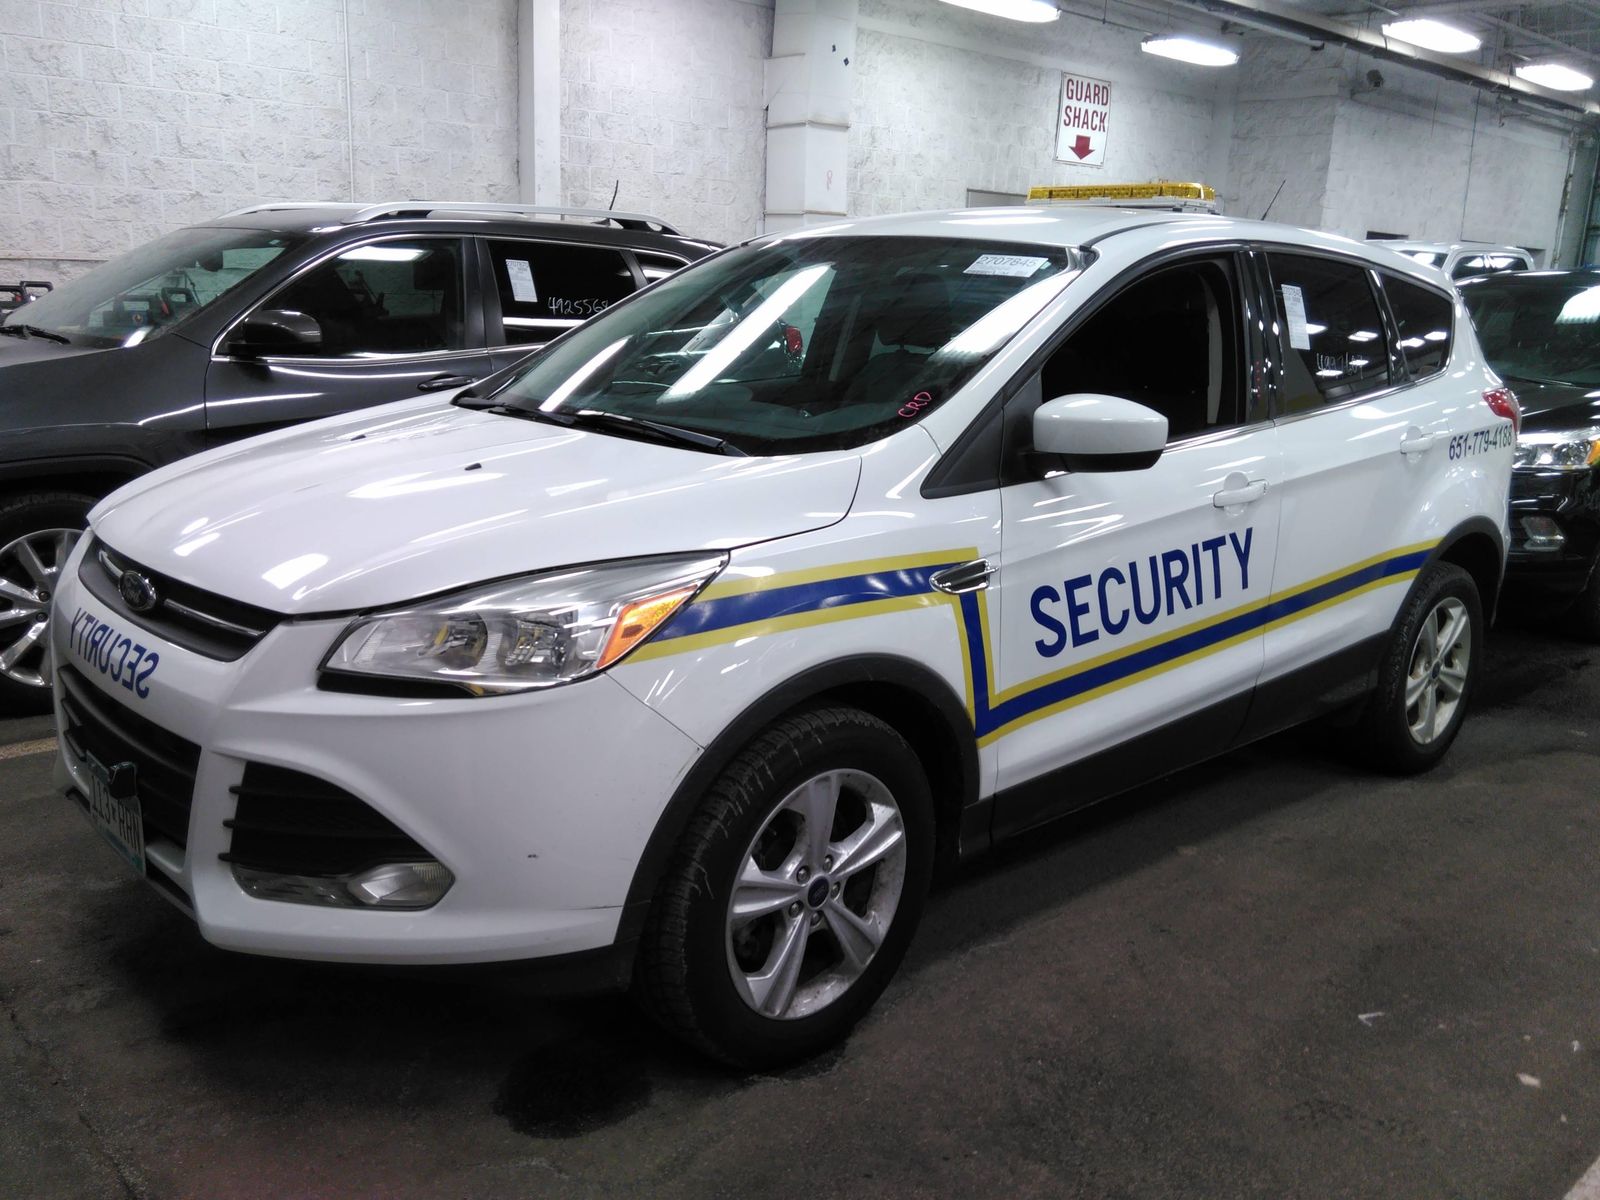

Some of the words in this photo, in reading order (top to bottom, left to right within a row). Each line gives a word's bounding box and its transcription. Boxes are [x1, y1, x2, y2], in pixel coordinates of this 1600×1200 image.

[1066, 78, 1109, 106] GUARD
[1063, 105, 1107, 133] SHACK
[898, 391, 932, 418] CRD
[1449, 424, 1513, 461] 651-779-4188
[1030, 527, 1253, 658] SECURITY
